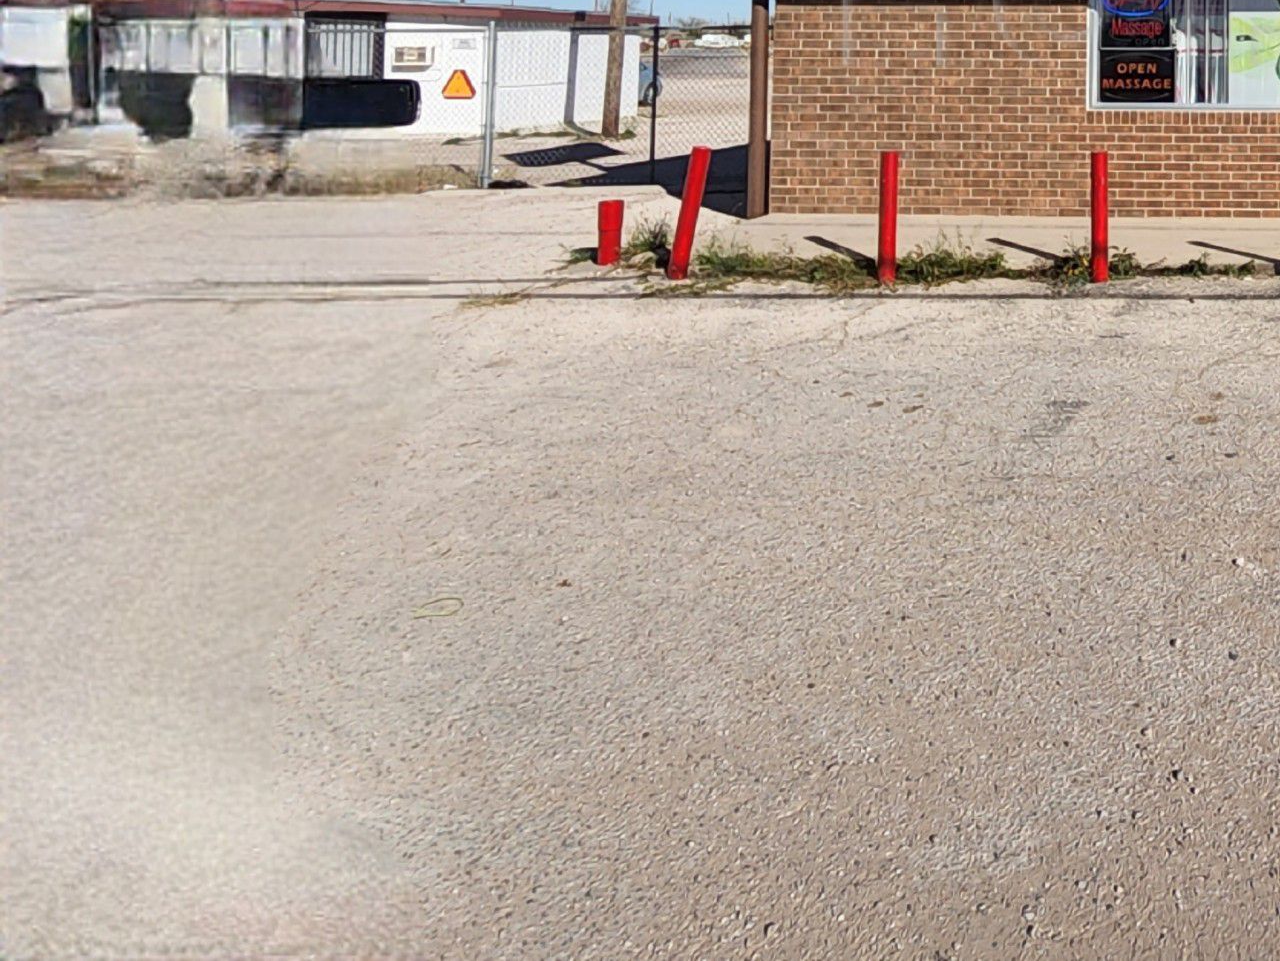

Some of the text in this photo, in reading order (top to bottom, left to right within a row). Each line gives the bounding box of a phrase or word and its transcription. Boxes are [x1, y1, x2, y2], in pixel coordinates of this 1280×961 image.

[1111, 19, 1164, 38] Massage
[1116, 62, 1157, 74] OPEN
[1101, 78, 1173, 90] MASSAGE
